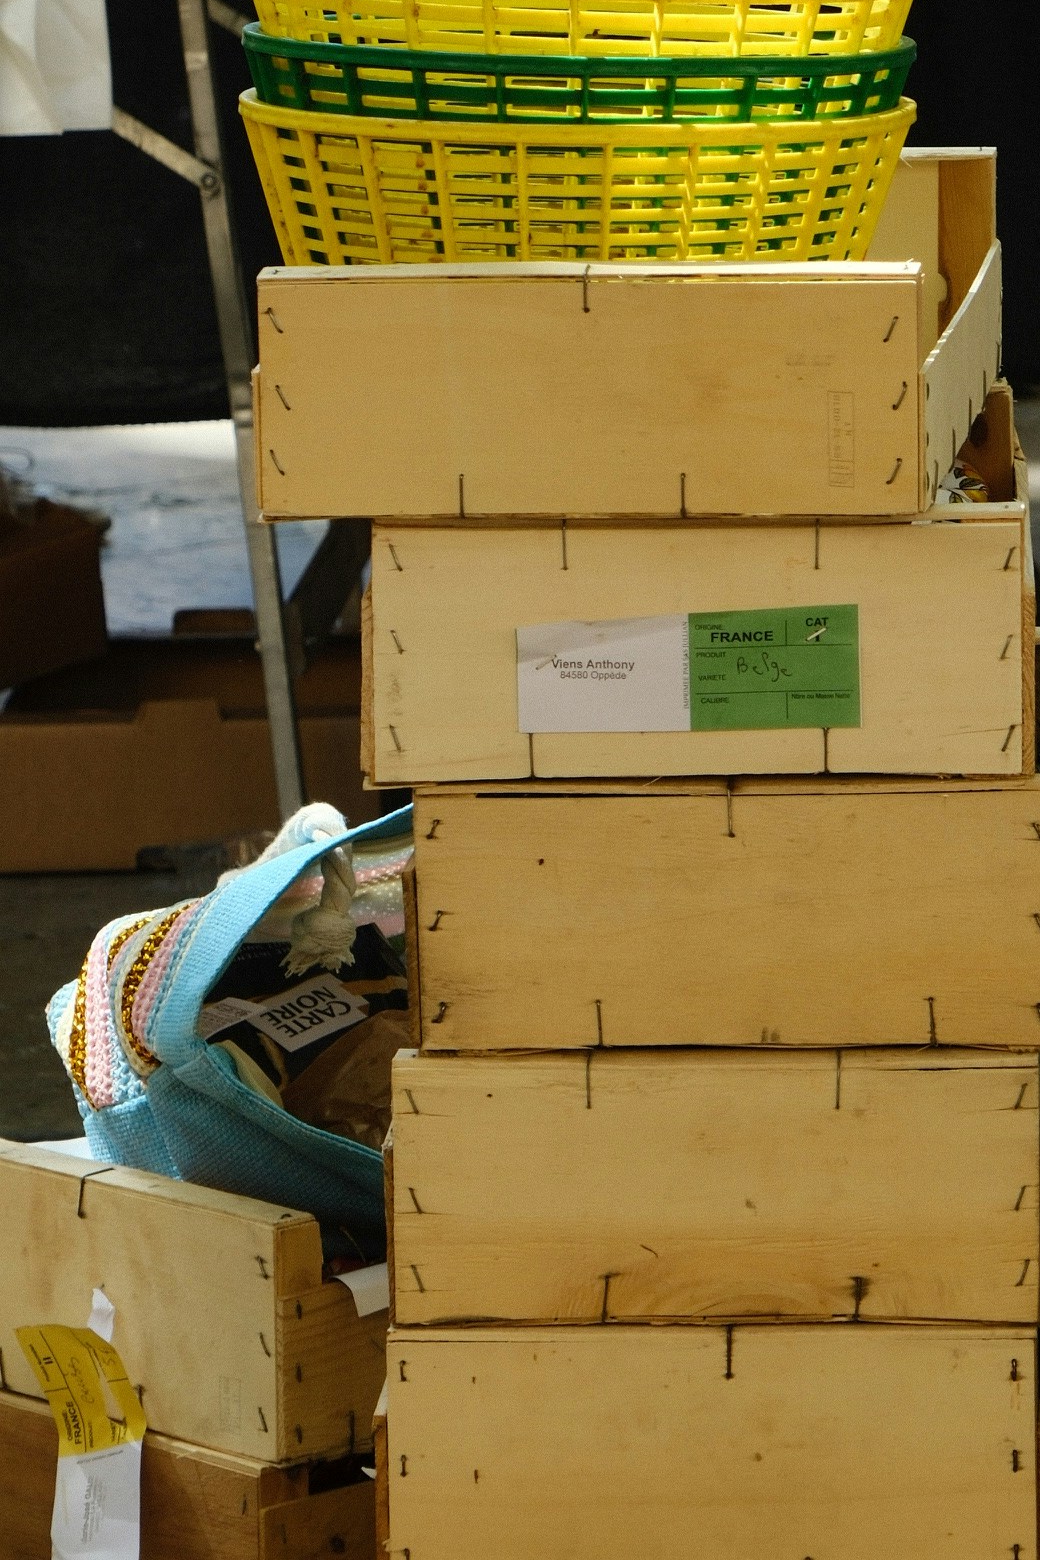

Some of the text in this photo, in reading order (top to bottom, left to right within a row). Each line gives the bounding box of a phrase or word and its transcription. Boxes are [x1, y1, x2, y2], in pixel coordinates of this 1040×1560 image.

[805, 617, 829, 627] CAT
[710, 630, 774, 643] FRANCE
[551, 658, 635, 671] Viens Anthony
[260, 986, 337, 1027] NOIRE
[276, 1000, 351, 1038] CARTE
[66, 1401, 82, 1445] FRANCE
